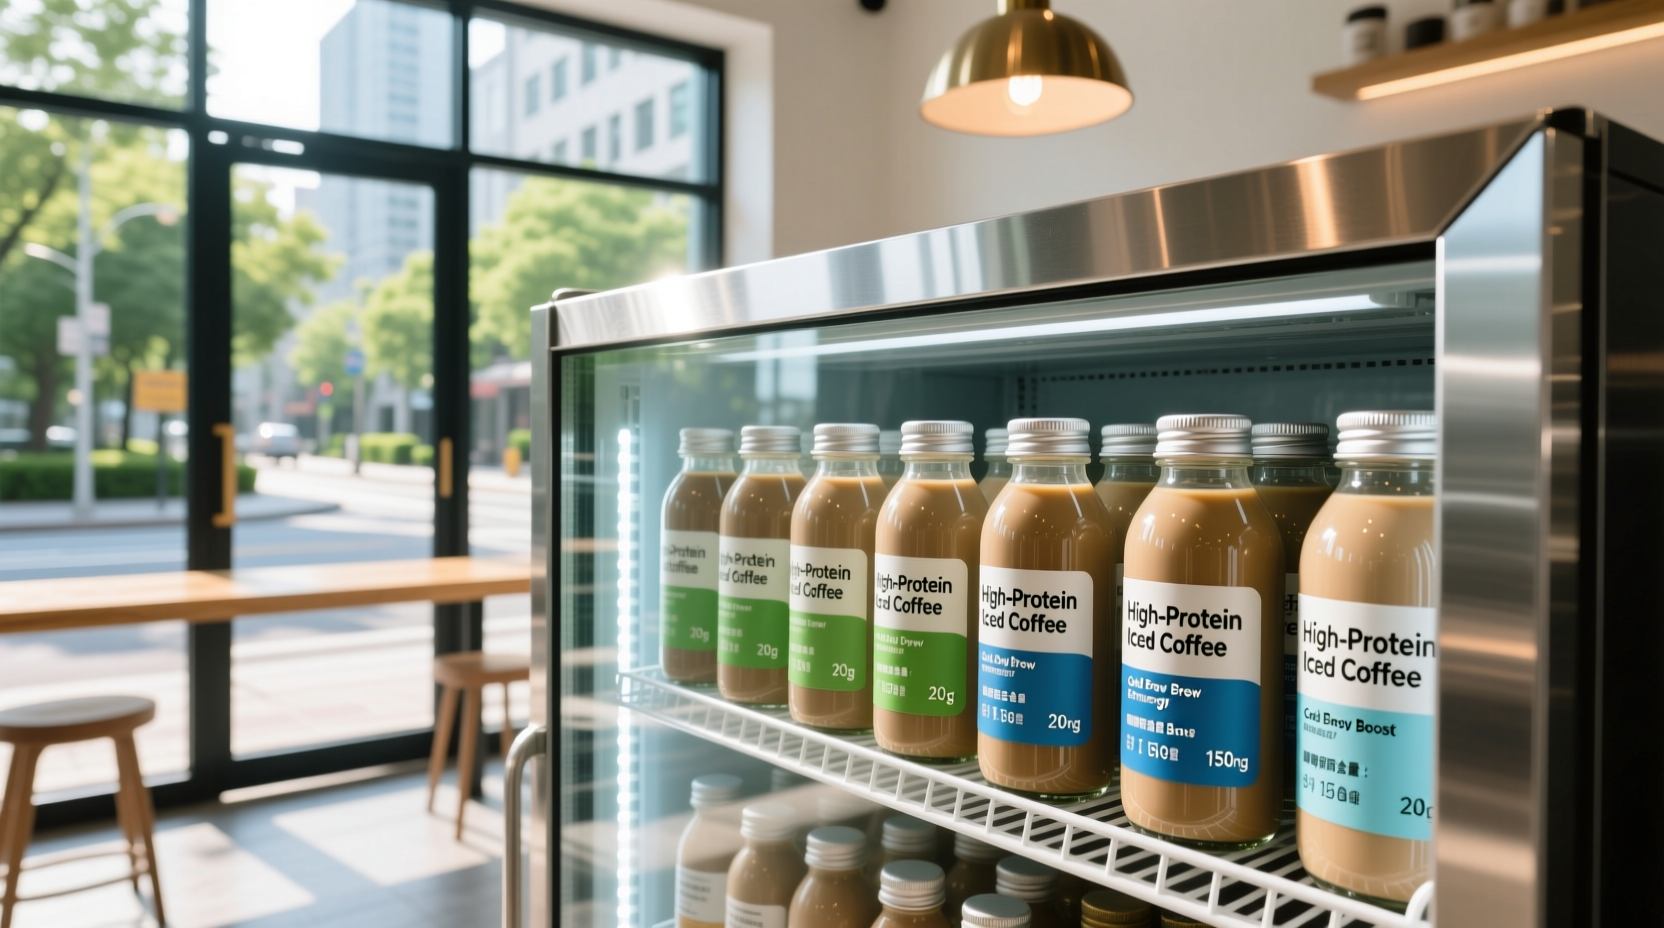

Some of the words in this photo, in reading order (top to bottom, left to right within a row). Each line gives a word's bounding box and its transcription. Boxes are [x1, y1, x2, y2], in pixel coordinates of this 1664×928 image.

[893, 595, 943, 616] Coffee
[1127, 600, 1243, 631] High-Protein
[1009, 612, 1068, 634] Coffee
[690, 627, 710, 643] 20g
[1127, 627, 1156, 651] Iced
[1160, 631, 1228, 658] Coffee
[1303, 620, 1436, 658] High-Protein
[757, 643, 778, 660] 20g
[832, 663, 855, 682] 20g
[1303, 651, 1336, 678] Iced
[1341, 658, 1422, 688] Coffee
[928, 685, 955, 705] 20g
[1355, 718, 1397, 737] Boost
